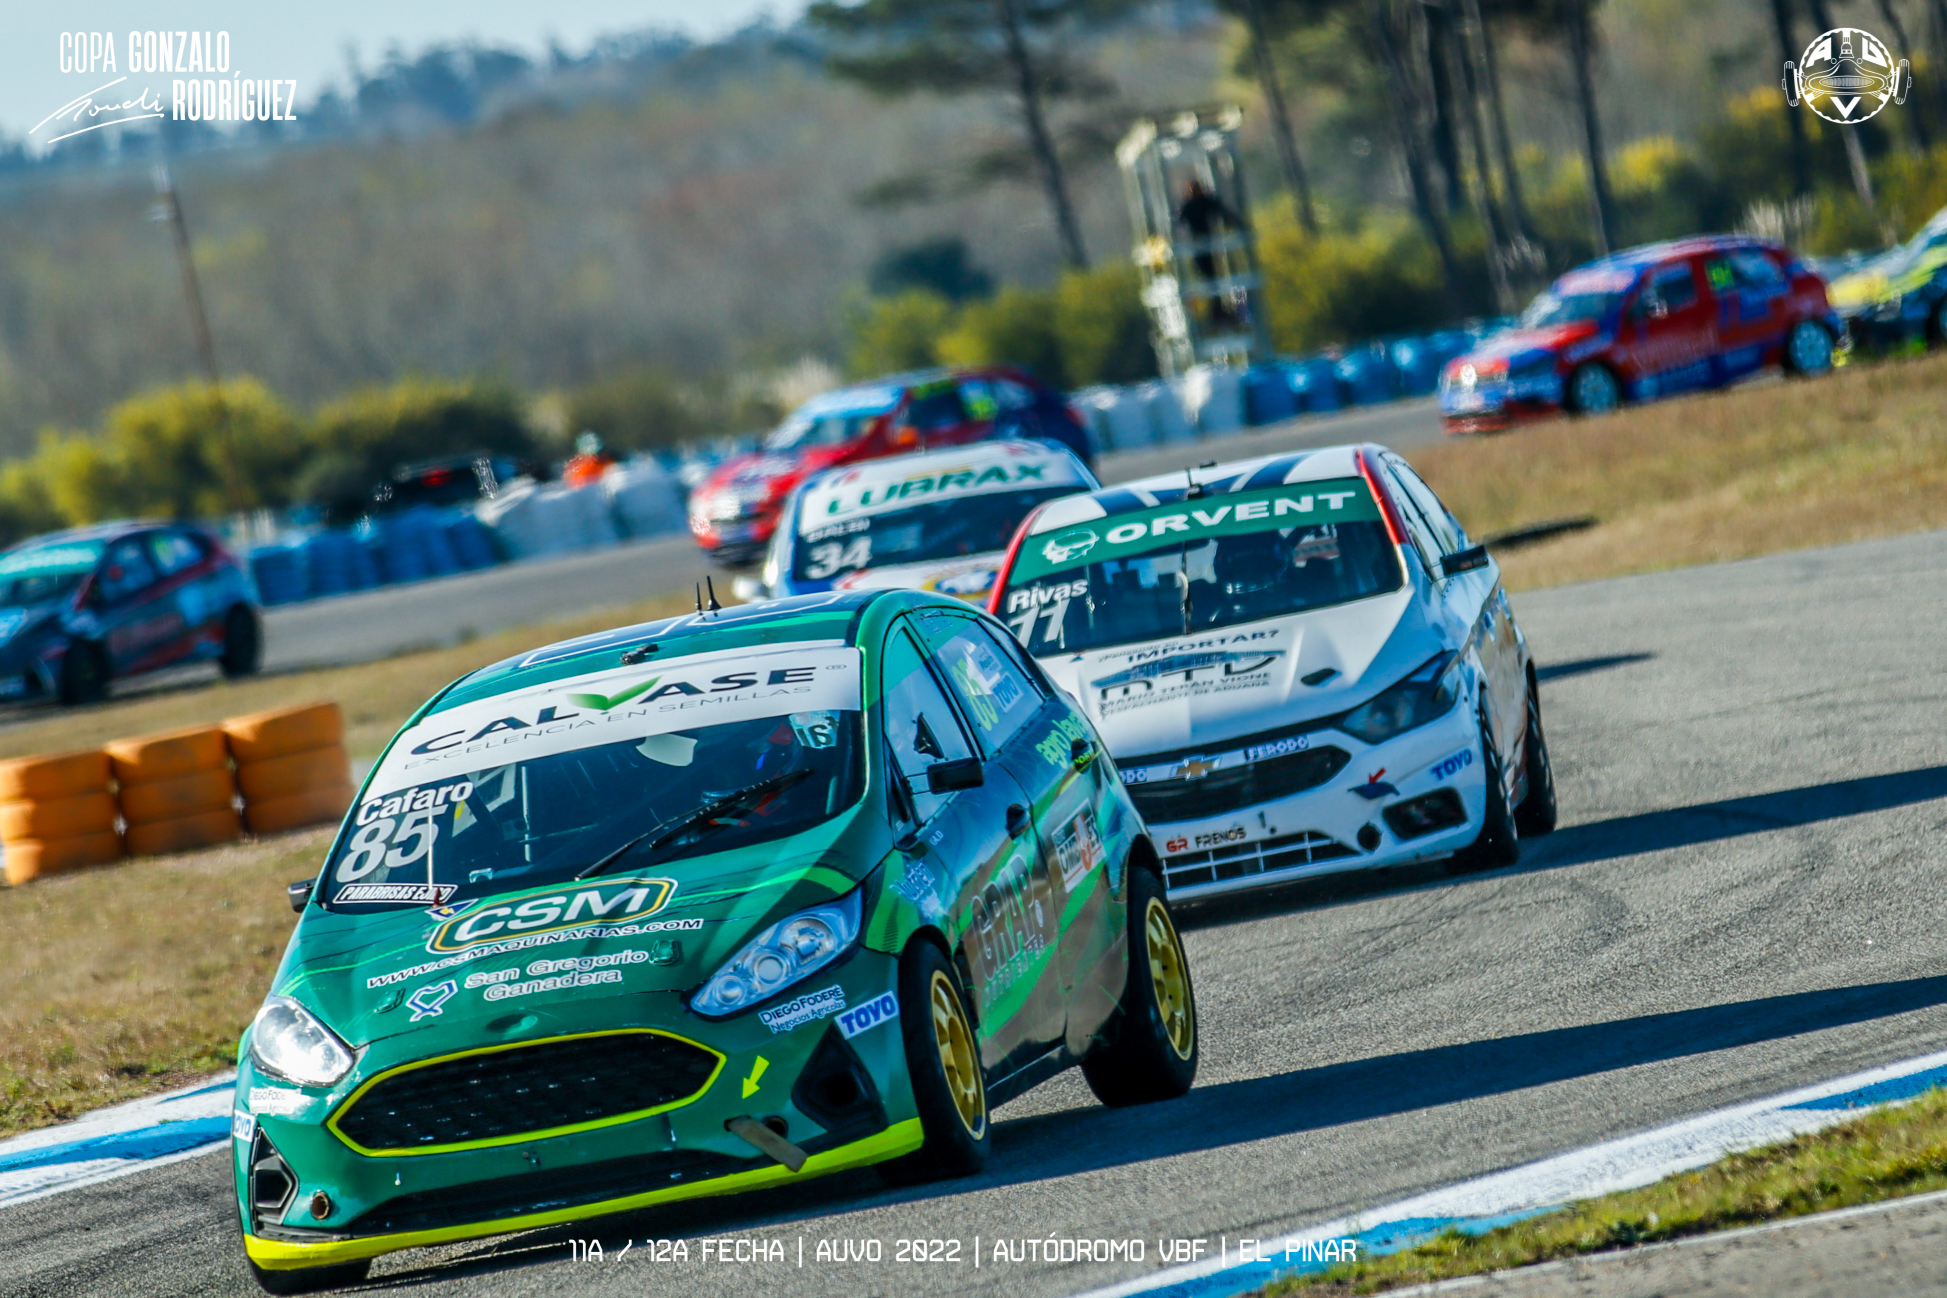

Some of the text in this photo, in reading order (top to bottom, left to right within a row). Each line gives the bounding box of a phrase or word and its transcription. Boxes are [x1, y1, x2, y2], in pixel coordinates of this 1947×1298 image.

[828, 463, 1046, 515] LUBRAX
[1106, 491, 1356, 544] ORVENT
[805, 536, 873, 580] 34
[1007, 578, 1089, 614] Rivas
[404, 685, 811, 770] EXCELENCIA EN SEMILLAS
[1430, 748, 1473, 781] TOYO
[355, 781, 474, 827] Cafaro
[336, 803, 439, 883] 85
[1195, 826, 1247, 849] FRENOS
[339, 885, 417, 901] PARABRISAS
[454, 887, 651, 942] CSM
[464, 949, 649, 991] San Gregorio
[484, 970, 622, 1001] Ganadera
[760, 1002, 801, 1024] DIEGO
[840, 994, 896, 1034] TOYO
